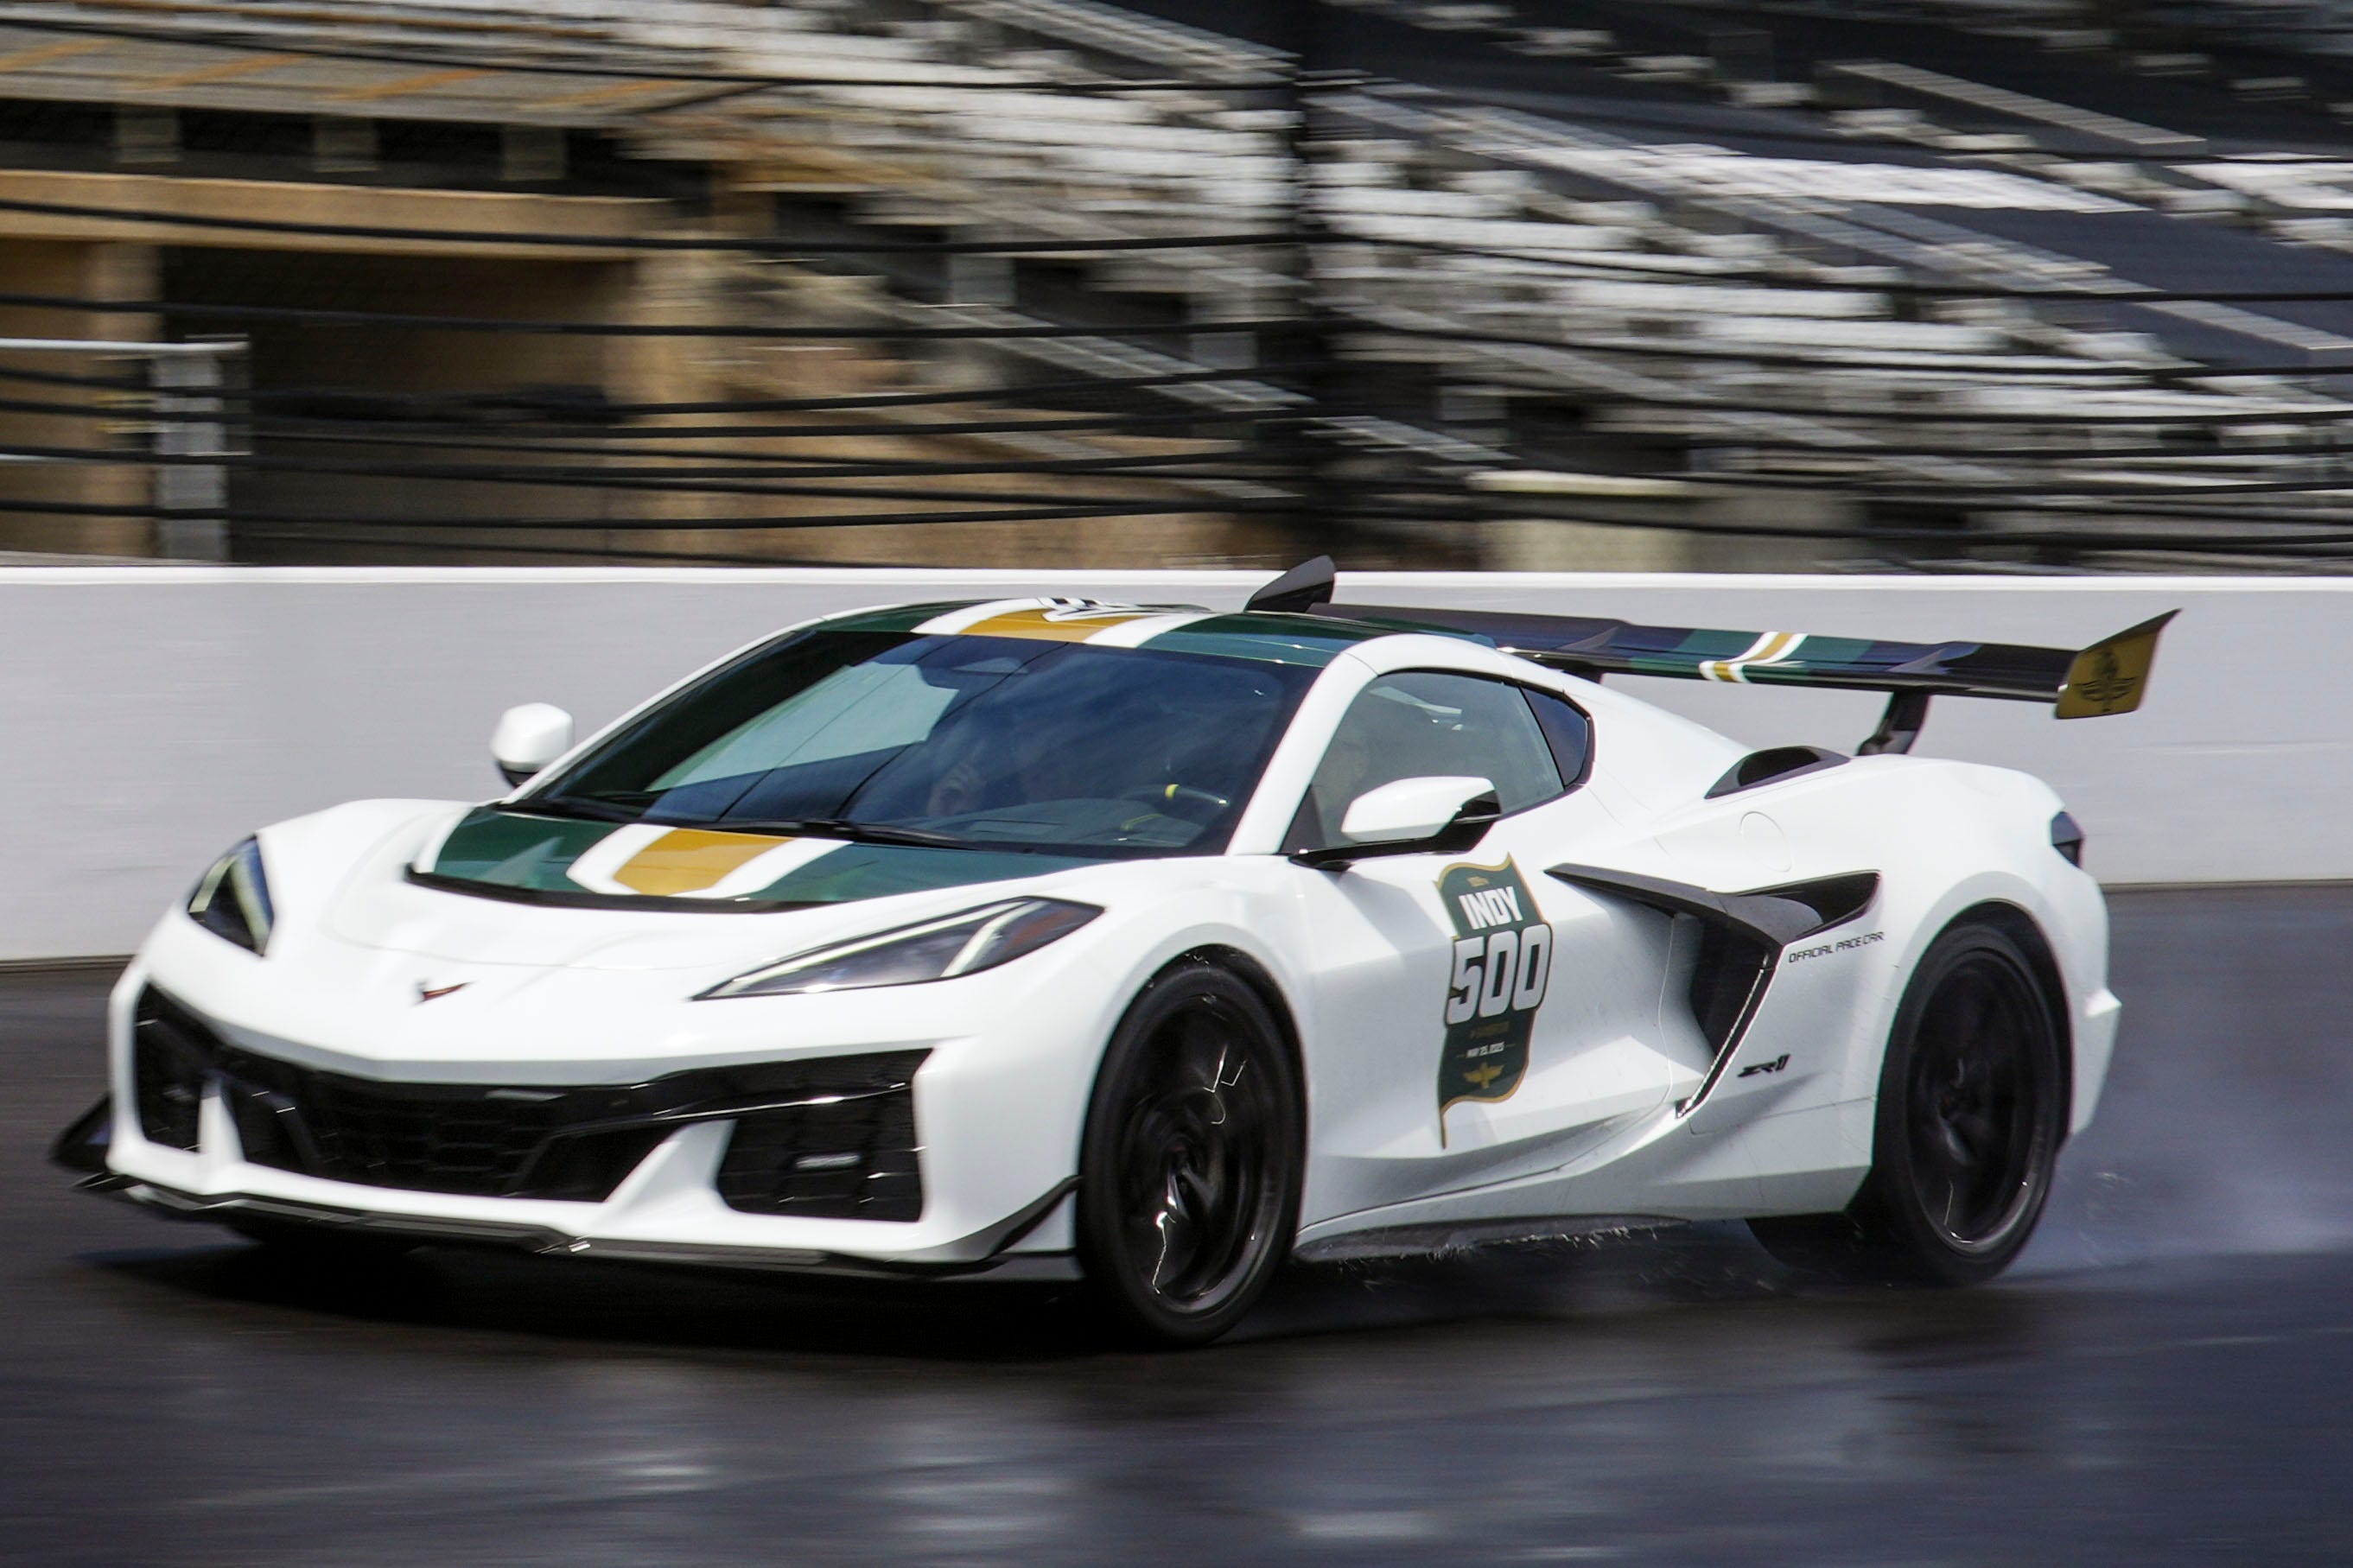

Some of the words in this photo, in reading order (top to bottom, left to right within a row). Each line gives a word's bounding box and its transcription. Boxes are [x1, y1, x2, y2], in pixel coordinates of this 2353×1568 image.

[1459, 886, 1523, 930] INDY
[1446, 924, 1551, 1025] 500
[1789, 945, 1833, 963] OFFICIAL
